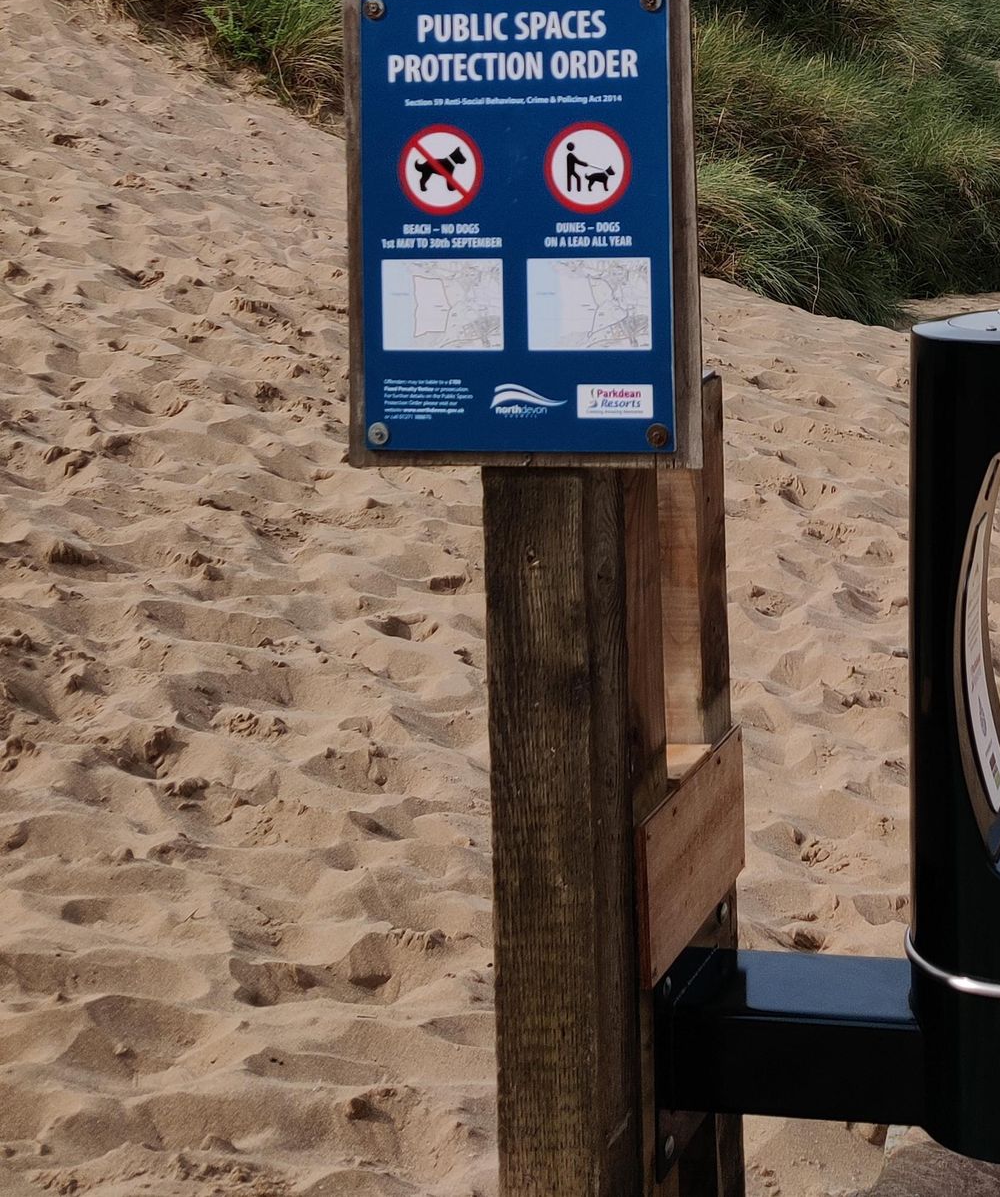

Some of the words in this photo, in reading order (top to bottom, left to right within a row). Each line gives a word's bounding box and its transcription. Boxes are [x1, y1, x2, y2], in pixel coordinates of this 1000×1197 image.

[417, 12, 508, 43] PUBLIC
[514, 9, 607, 40] SPACES
[388, 51, 543, 83] PROTECTION
[550, 49, 638, 80] ORDER
[404, 98, 433, 107] Section
[526, 96, 549, 104] Crime
[550, 96, 557, 104] &
[557, 95, 588, 105] Policing
[589, 95, 601, 103] Act
[602, 94, 623, 102] 2014
[403, 224, 432, 235] BEACH
[441, 223, 455, 234] NO
[455, 223, 480, 234] DOGS
[556, 222, 586, 233] DUNES
[596, 221, 620, 233] DOGS
[381, 238, 395, 249] 1st
[396, 238, 416, 249] MAY
[416, 237, 429, 248] TO
[451, 236, 503, 248] SEPTEMBER
[544, 236, 558, 248] ON
[559, 236, 567, 247] A
[567, 236, 591, 247] LEAD
[591, 235, 608, 247] ALL
[608, 235, 632, 247] YEAR
[597, 388, 641, 398] Parkdean
[600, 398, 641, 408] Resorts
[495, 405, 548, 414] northdevon
